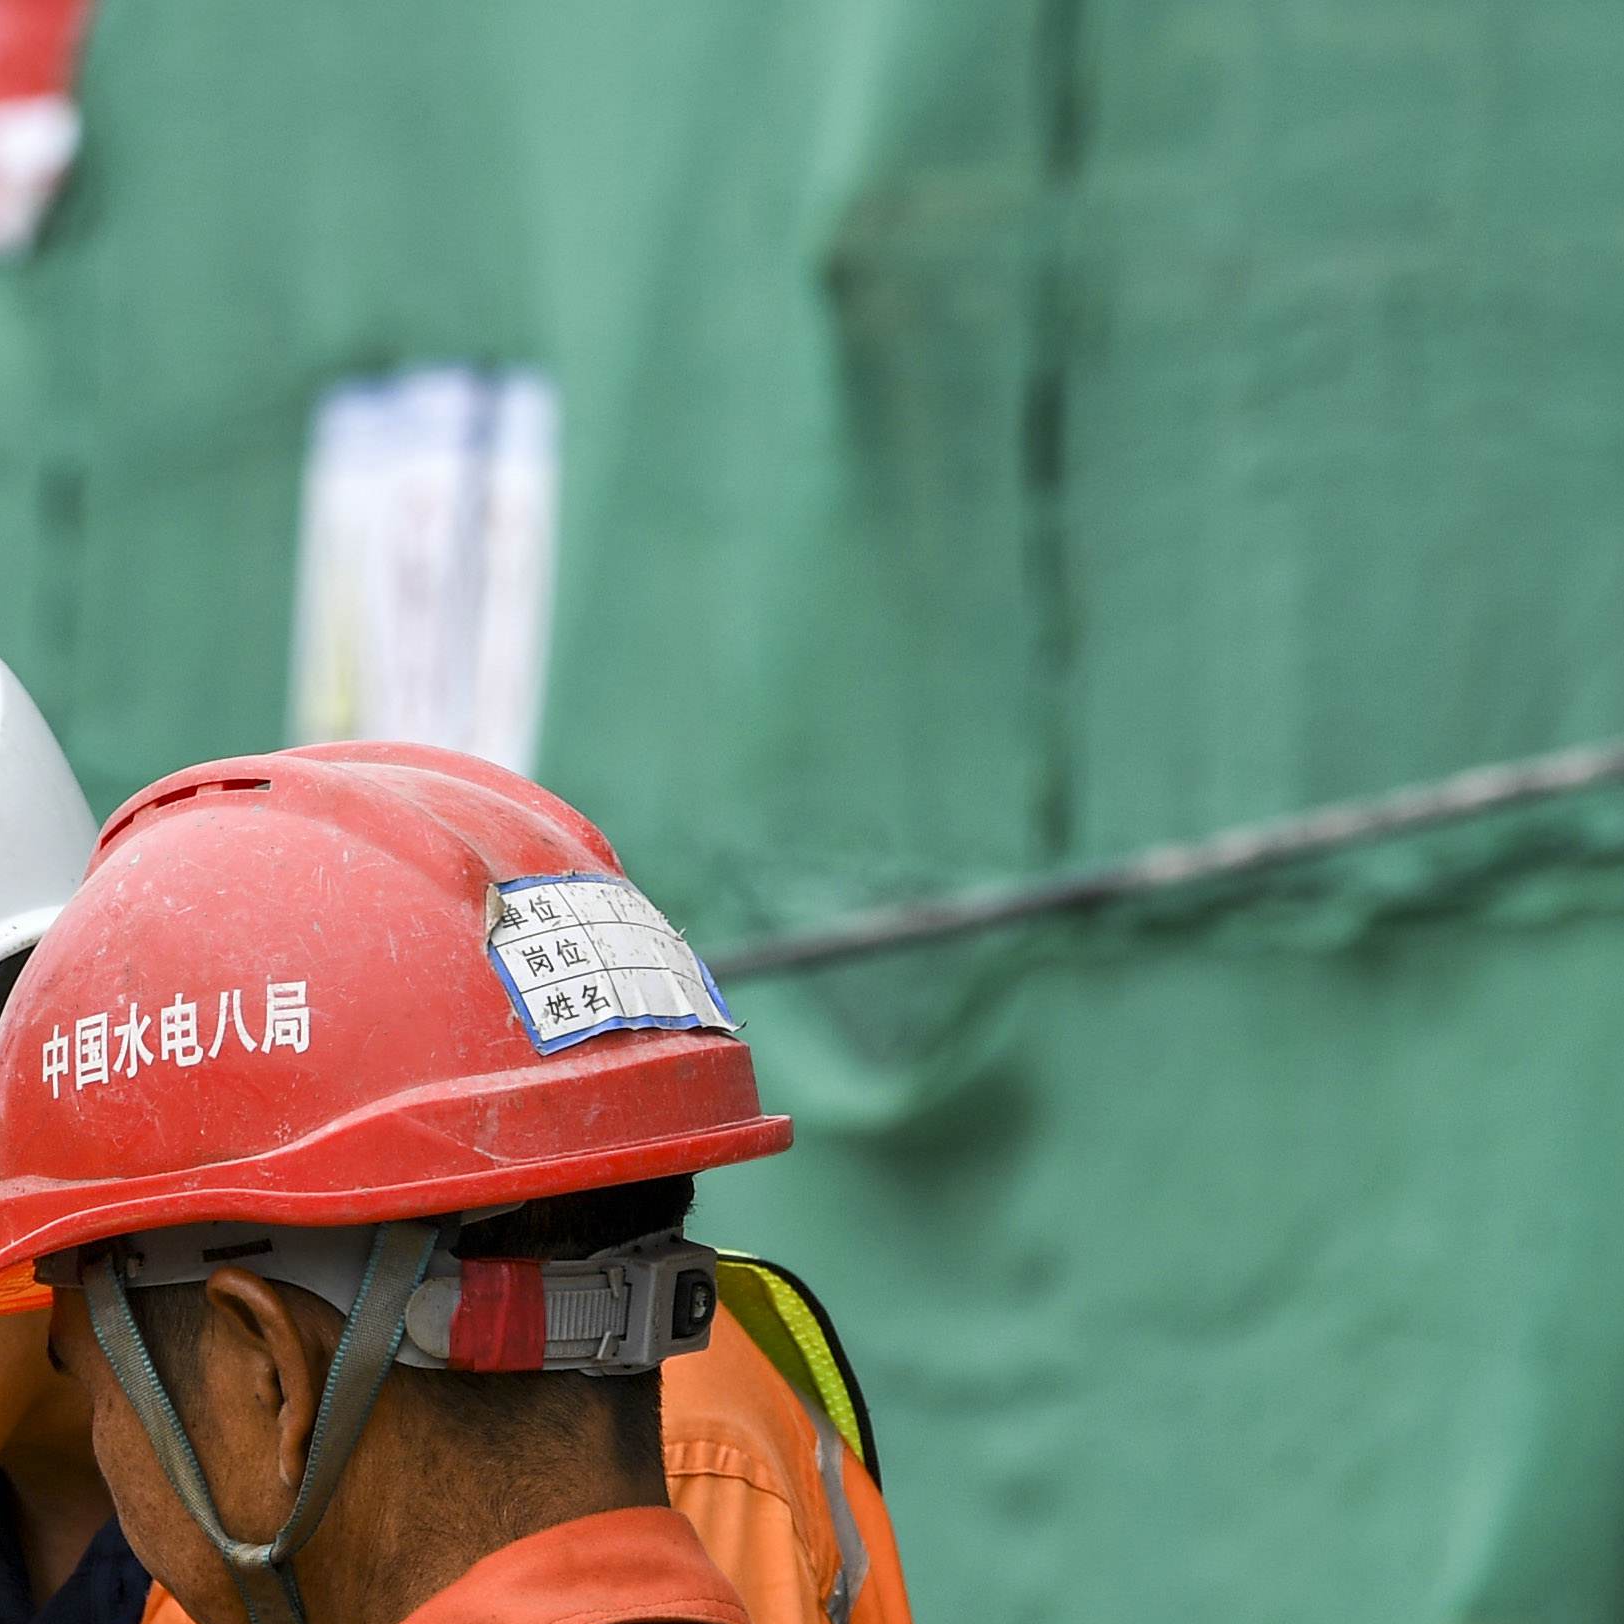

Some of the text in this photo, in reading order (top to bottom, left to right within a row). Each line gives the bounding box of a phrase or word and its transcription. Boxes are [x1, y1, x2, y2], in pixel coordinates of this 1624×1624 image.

[501, 894, 561, 931] 单位
[522, 938, 587, 978] 岗位
[546, 984, 611, 1024] 姓名
[42, 980, 311, 1100] 中国水电八局
